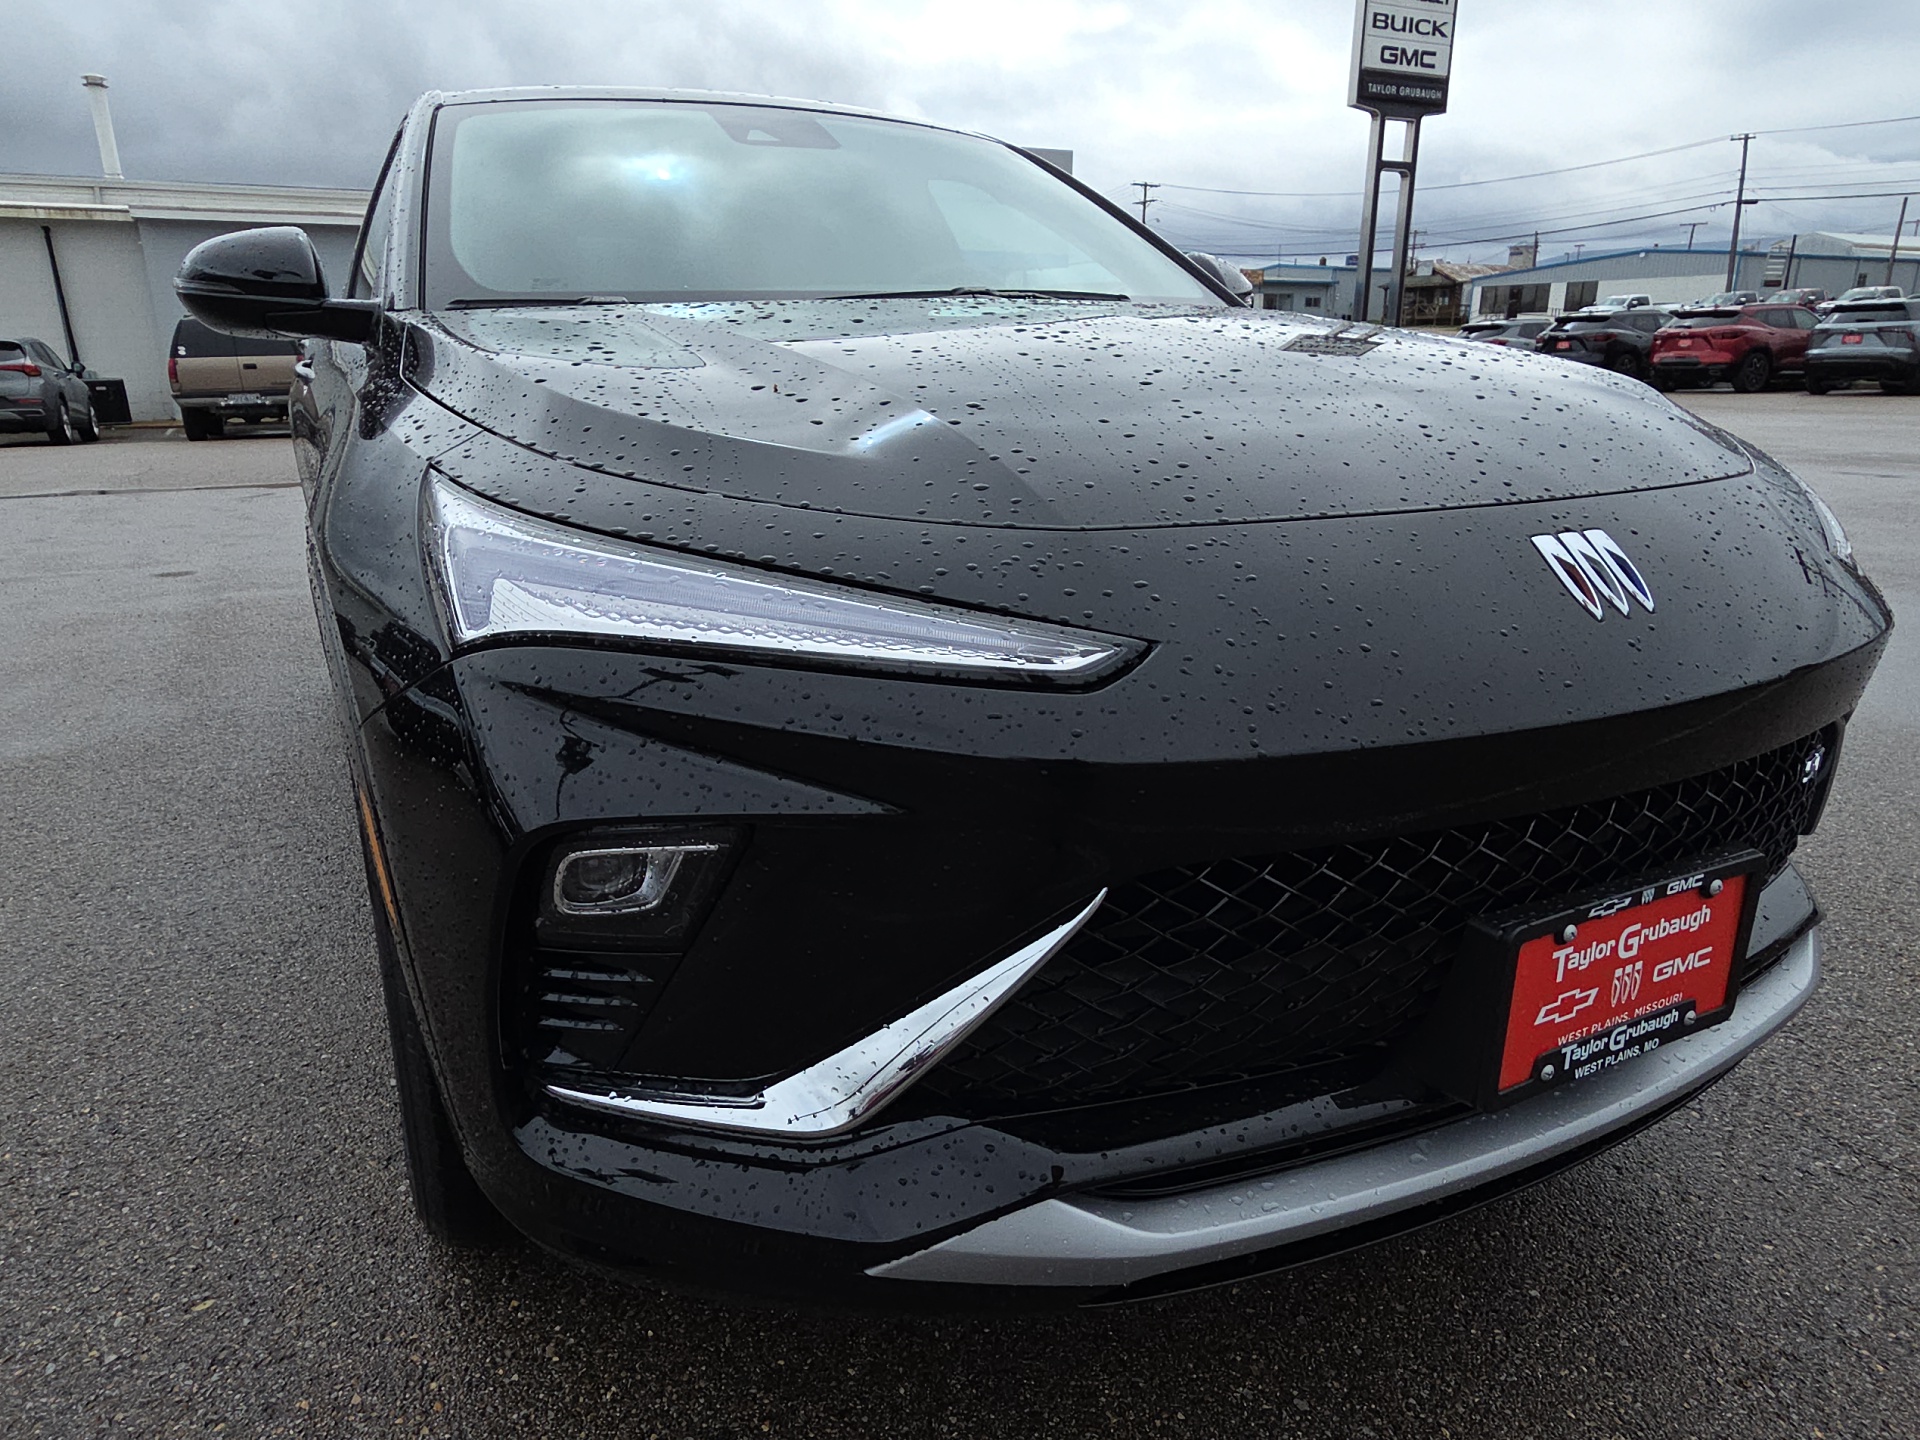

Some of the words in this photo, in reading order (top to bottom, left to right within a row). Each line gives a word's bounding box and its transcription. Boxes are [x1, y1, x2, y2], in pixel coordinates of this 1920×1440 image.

[1372, 12, 1448, 38] BUICK
[1380, 45, 1437, 69] GMC
[1368, 83, 1397, 95] TAYLOR
[1399, 86, 1442, 99] GRUBAUGH
[1666, 874, 1705, 895] GMC
[1552, 939, 1616, 983] Taylor
[1618, 904, 1711, 959] Grubaugh
[1653, 946, 1713, 983] GMC
[1557, 1026, 1589, 1046] WEST
[1634, 992, 1683, 1017] MISSOURI
[1561, 1036, 1609, 1070] Taylor
[1609, 1008, 1679, 1051] Grubaugh
[1574, 1058, 1604, 1080] WEST
[1604, 1045, 1641, 1068] PLAINS,
[1643, 1037, 1660, 1053] MO
